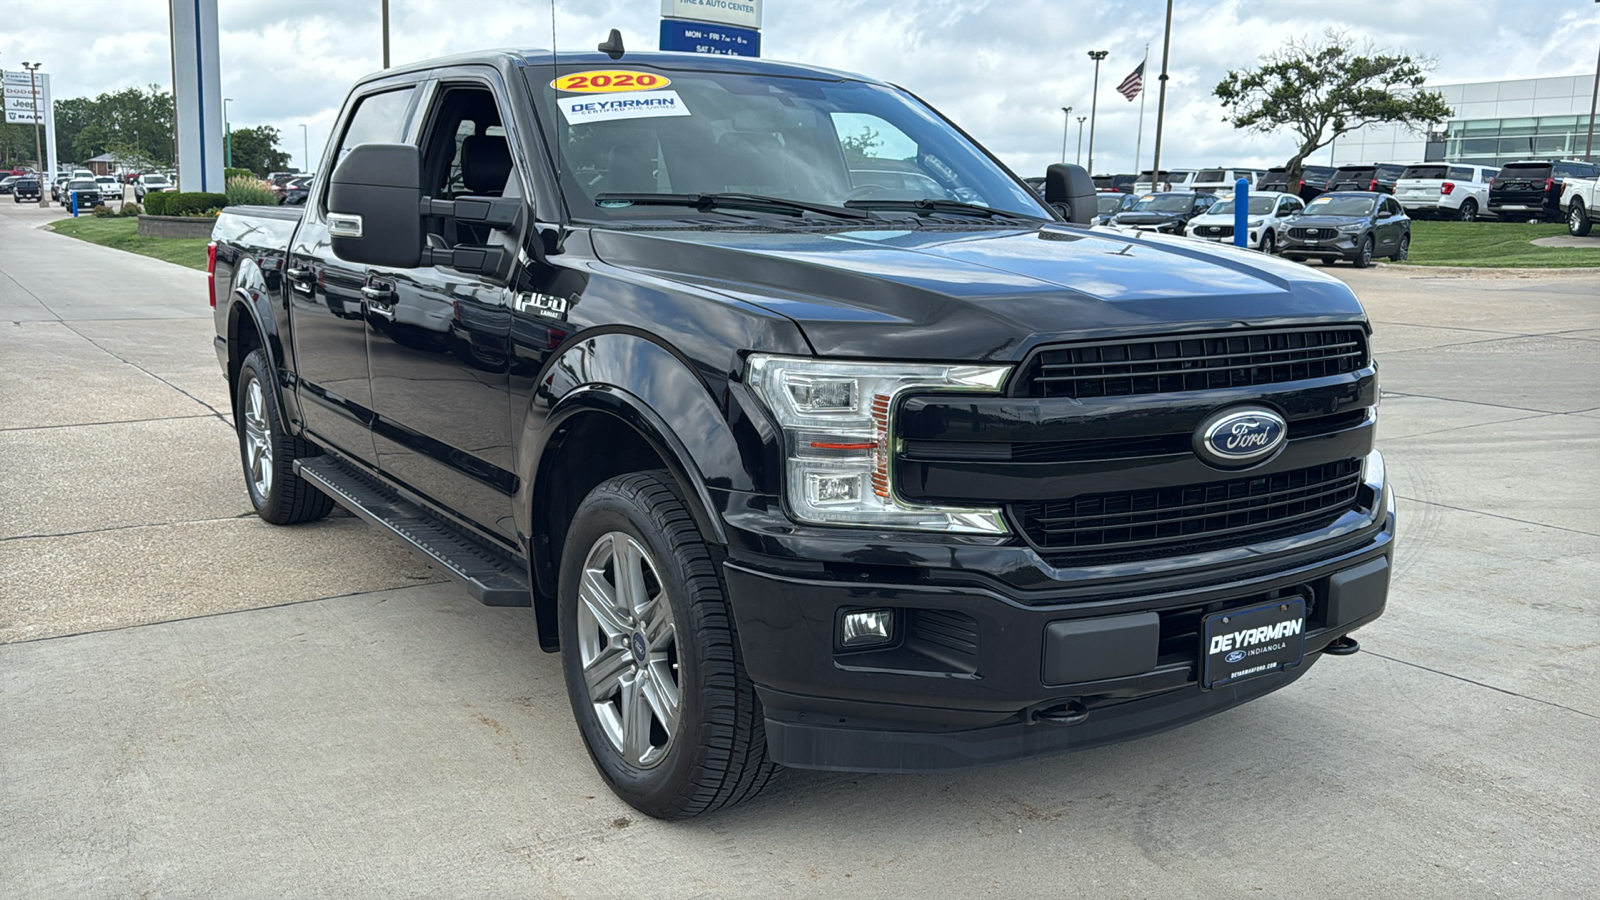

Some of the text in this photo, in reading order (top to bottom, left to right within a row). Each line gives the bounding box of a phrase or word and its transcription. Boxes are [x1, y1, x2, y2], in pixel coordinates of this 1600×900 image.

[705, 0, 727, 9] AUTO
[728, 2, 755, 14] CENTER
[685, 30, 702, 39] MON
[709, 32, 720, 40] FRI
[696, 45, 709, 53] SAT
[566, 74, 656, 89] 2020
[571, 98, 675, 113] DEYARMAN
[581, 107, 626, 115] CERTIFIED
[1226, 422, 1270, 449] Ford
[1209, 618, 1303, 655] DEYARMAN
[1247, 642, 1287, 657] INDIANOLA
